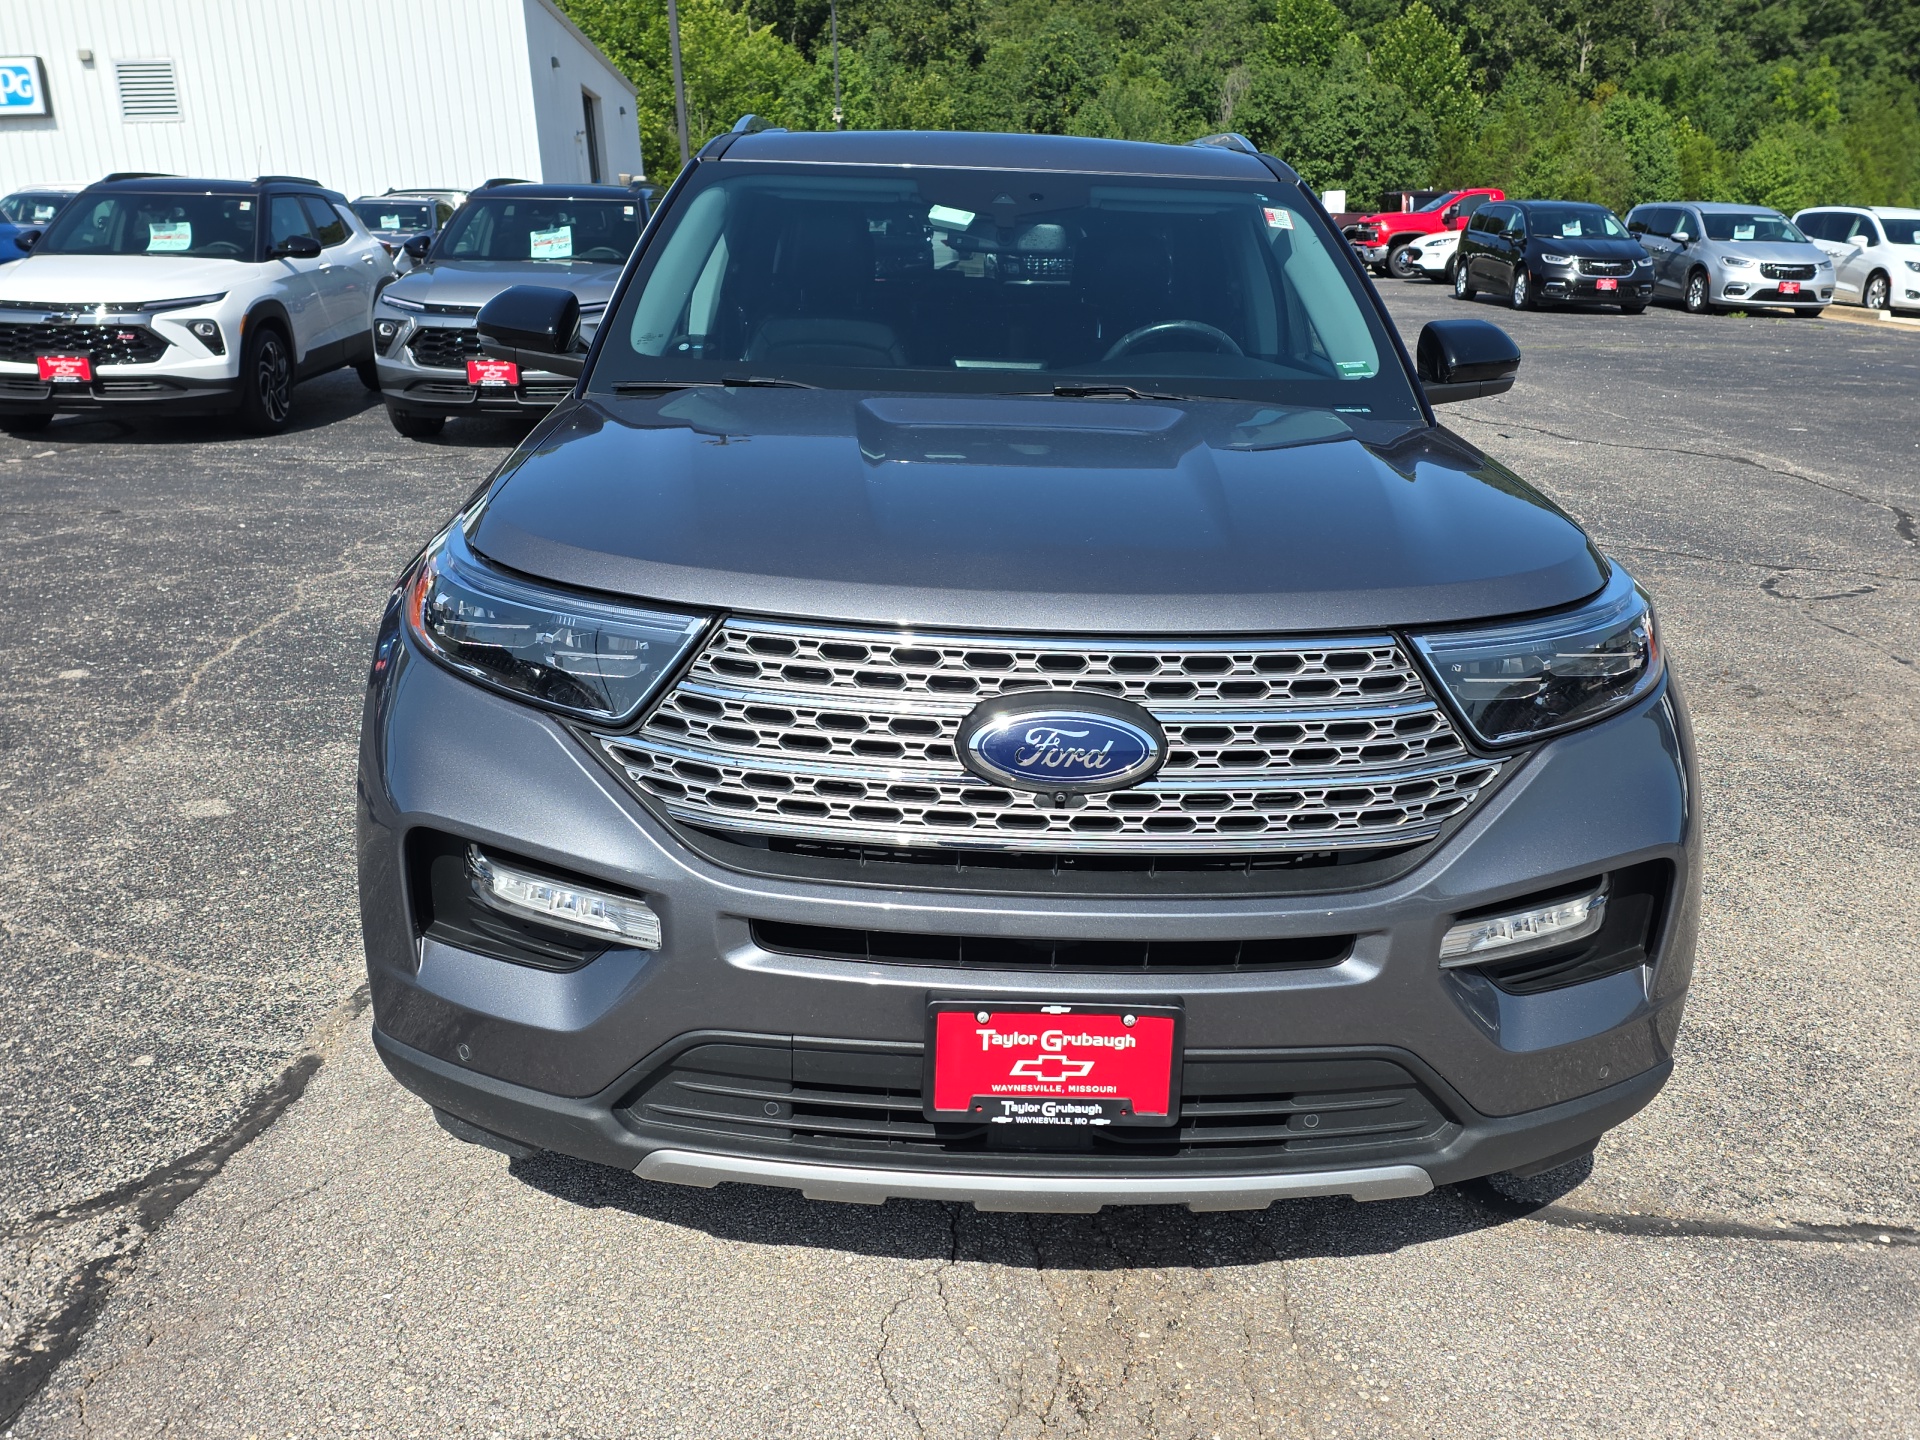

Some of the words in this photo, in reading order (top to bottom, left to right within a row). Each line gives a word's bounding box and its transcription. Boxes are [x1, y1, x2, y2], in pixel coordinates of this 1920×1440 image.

[1014, 726, 1114, 769] Ford
[976, 1029, 1037, 1051] Taylor
[1040, 1029, 1136, 1051] Grubaugh
[991, 1084, 1065, 1094] WAYNESVILLE,
[1068, 1085, 1117, 1094] MISSOURI
[1001, 1101, 1041, 1115] Taylor
[1042, 1102, 1102, 1117] Grubaugh
[1015, 1116, 1073, 1126] WAYNESVILLE,
[1074, 1117, 1088, 1126] MO
